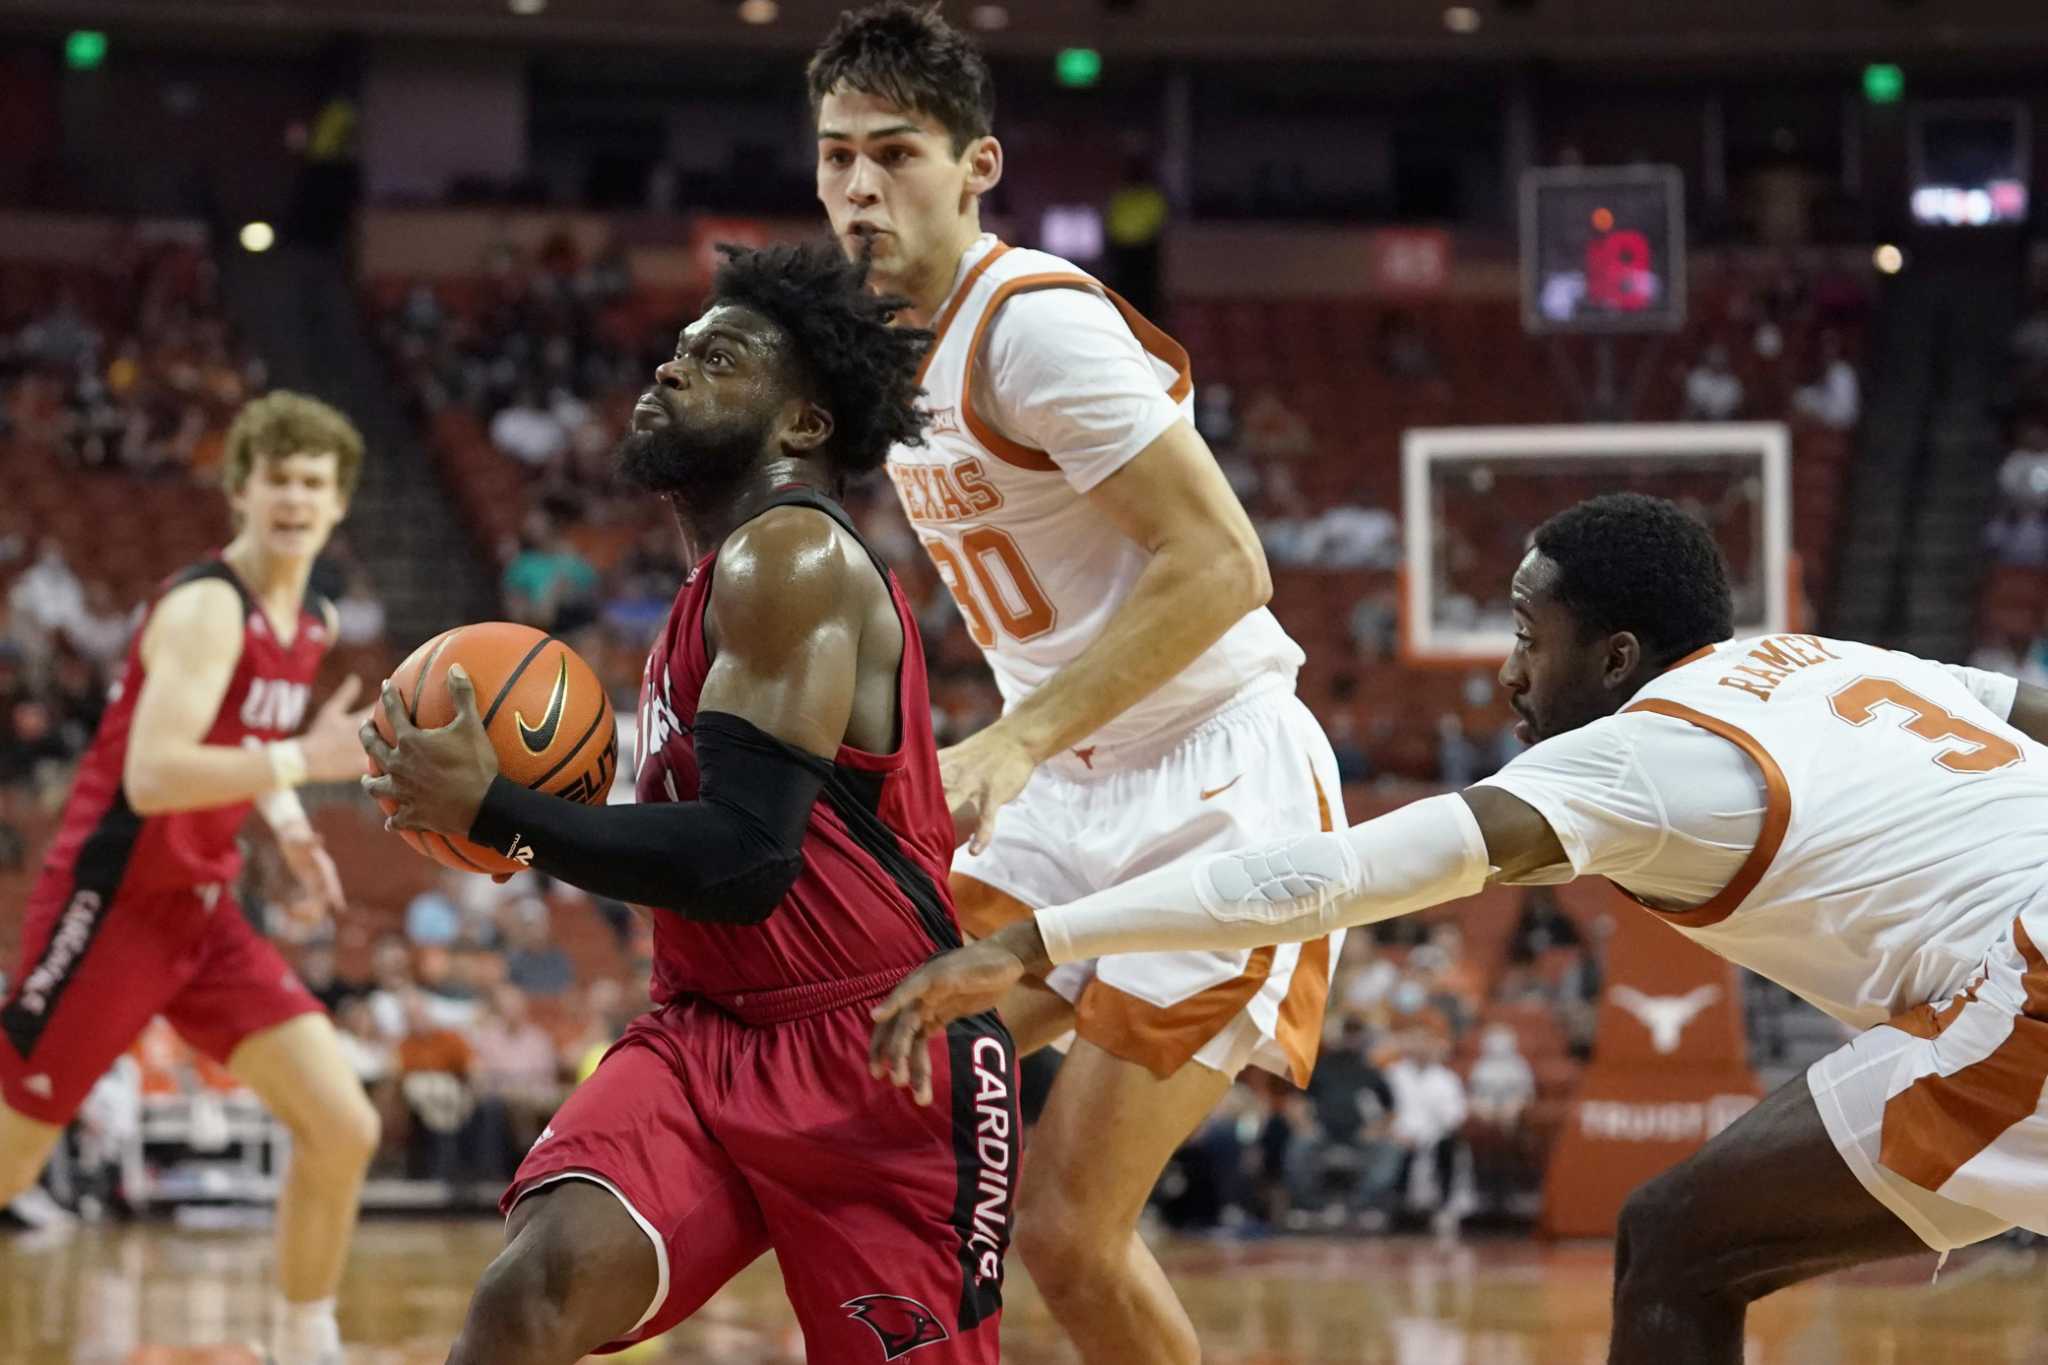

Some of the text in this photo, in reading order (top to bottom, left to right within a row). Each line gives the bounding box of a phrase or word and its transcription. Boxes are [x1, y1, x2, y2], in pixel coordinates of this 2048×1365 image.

[892, 455, 1004, 522] EXAS
[1718, 635, 1842, 702] RAMEY
[1826, 674, 2025, 774] 3
[554, 741, 618, 806] ELIT
